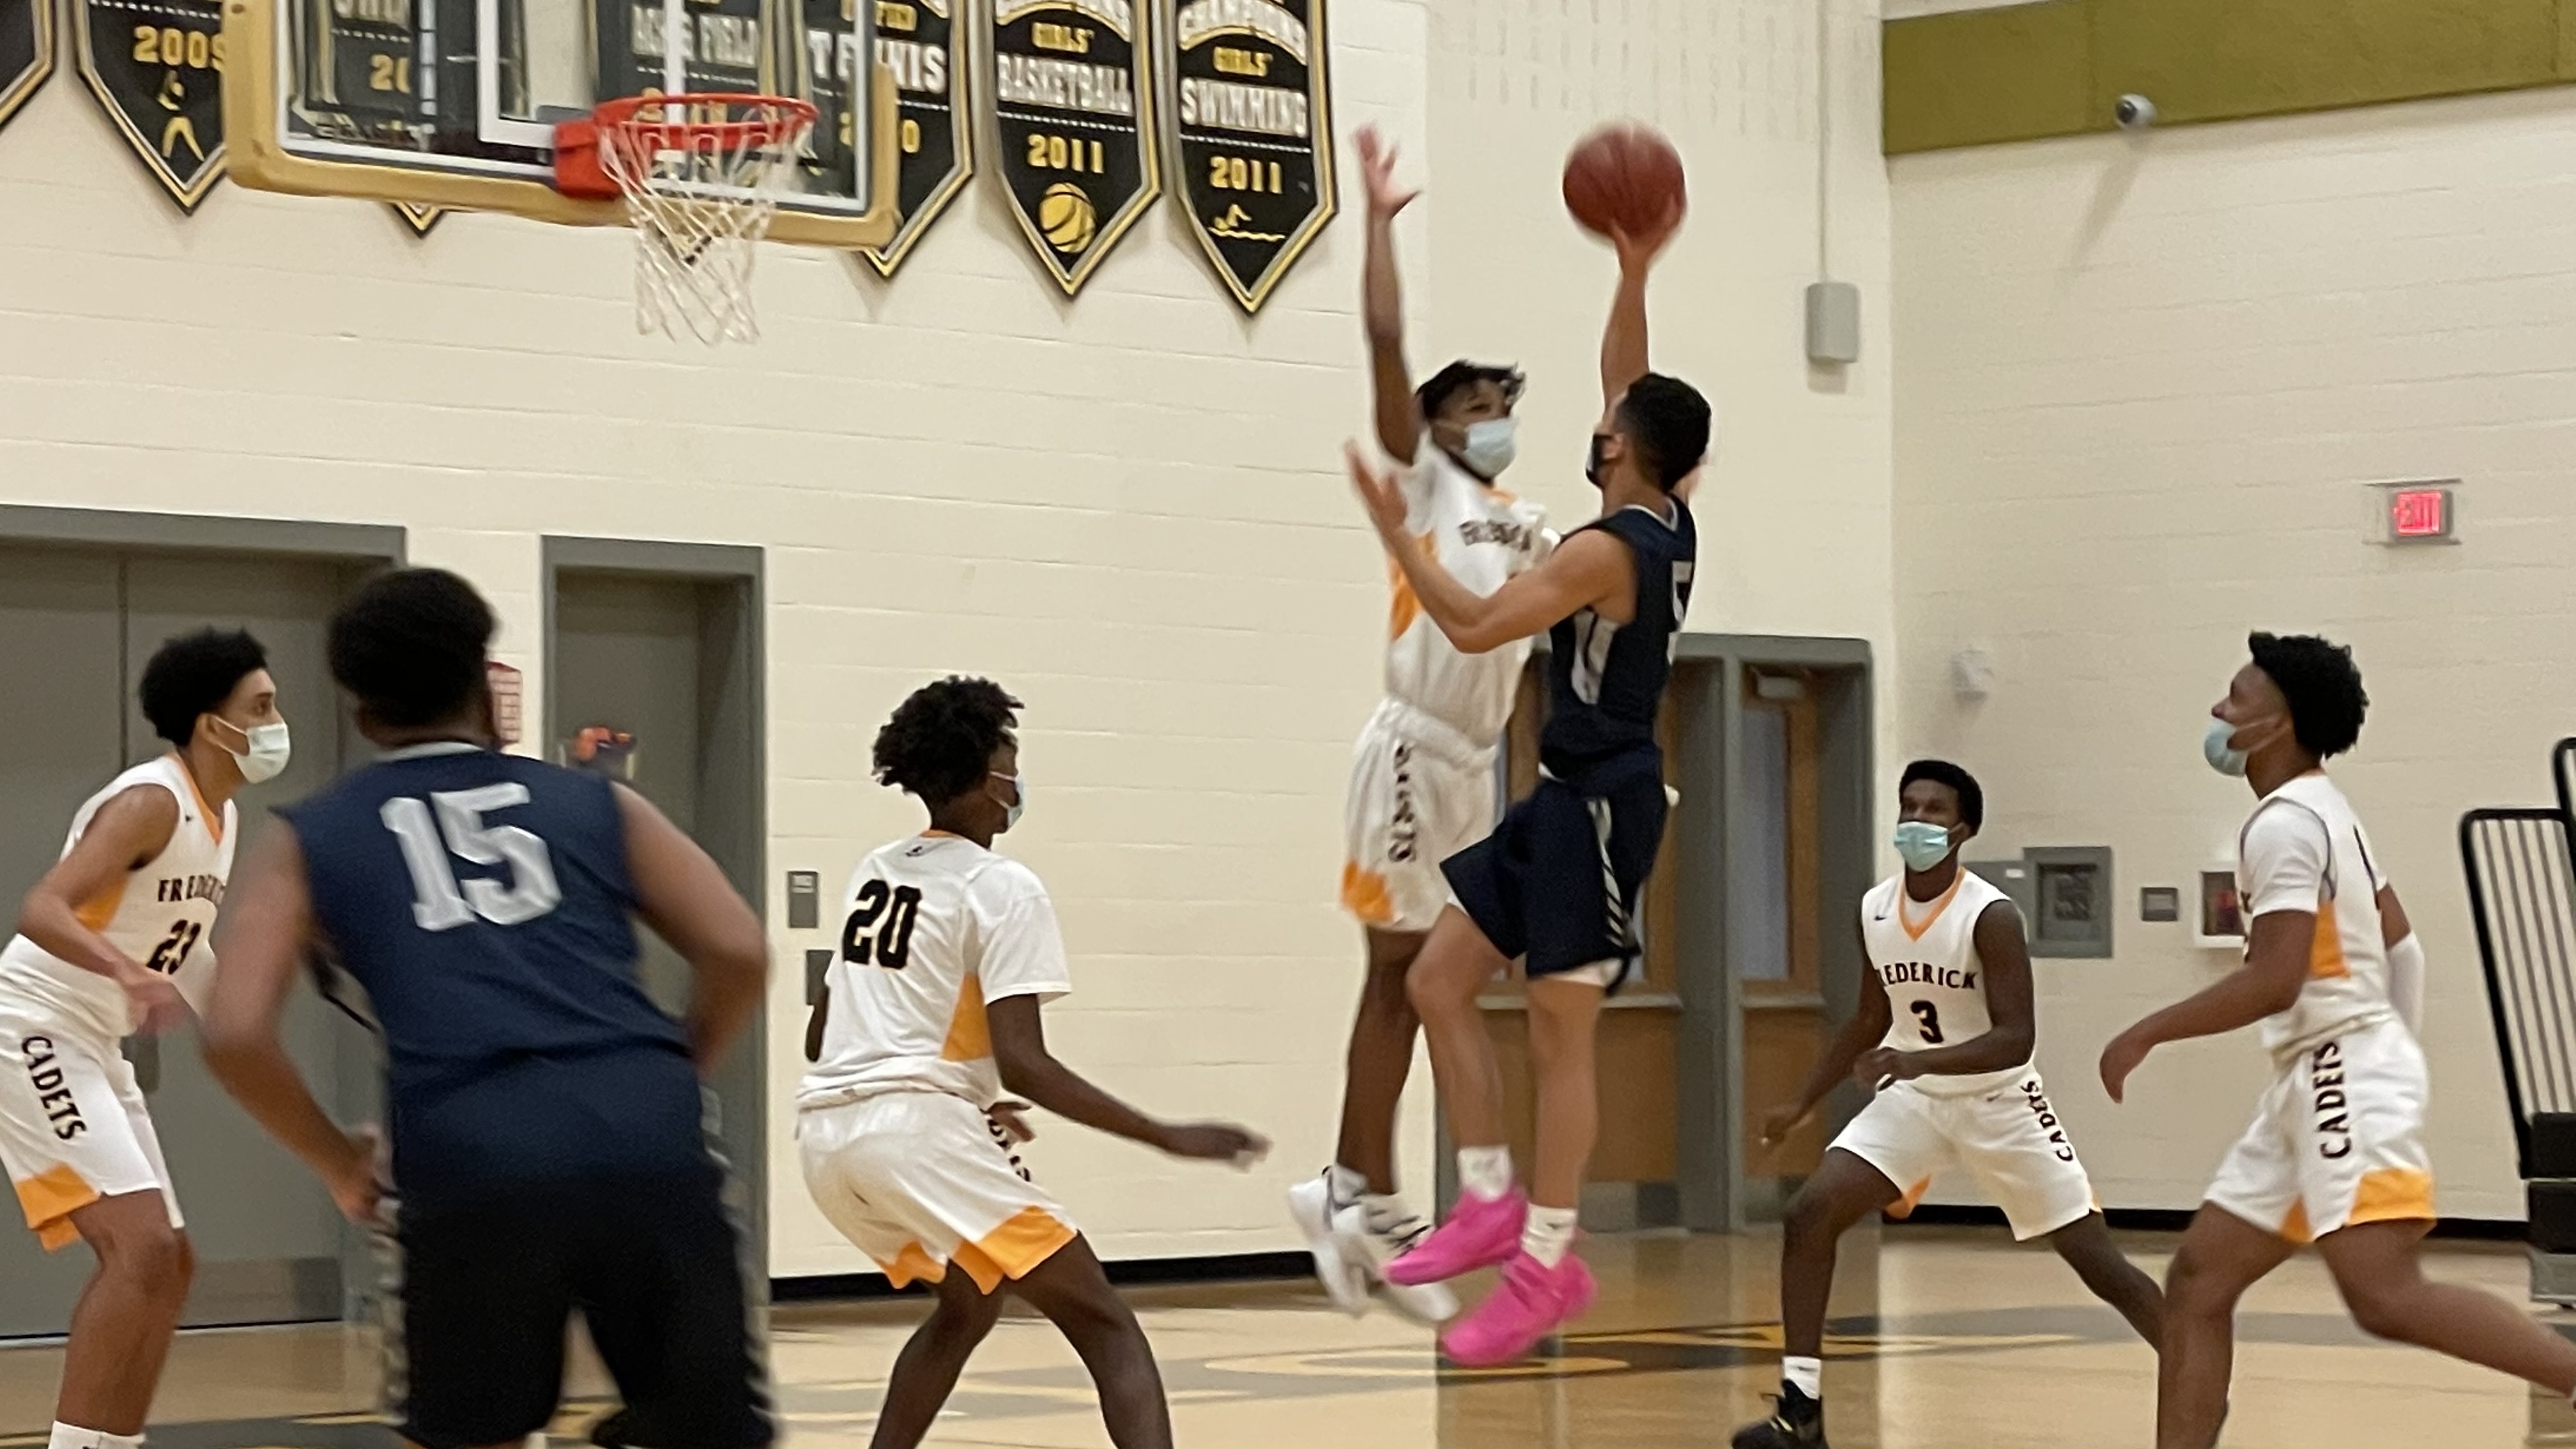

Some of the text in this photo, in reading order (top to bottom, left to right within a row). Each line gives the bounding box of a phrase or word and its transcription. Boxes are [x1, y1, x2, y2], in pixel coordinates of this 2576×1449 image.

[997, 53, 1133, 117] BASKETBALL
[1181, 77, 1307, 138] SWIMMING
[1027, 134, 1104, 174] 2011
[1210, 156, 1282, 194] 2011
[379, 781, 563, 932] 15
[145, 918, 202, 976] 23
[842, 878, 923, 970] 20
[1910, 999, 1944, 1044] 3
[22, 1036, 88, 1140] CADETS
[2311, 1041, 2352, 1160] CADETS
[2020, 1080, 2074, 1162] CADETS
